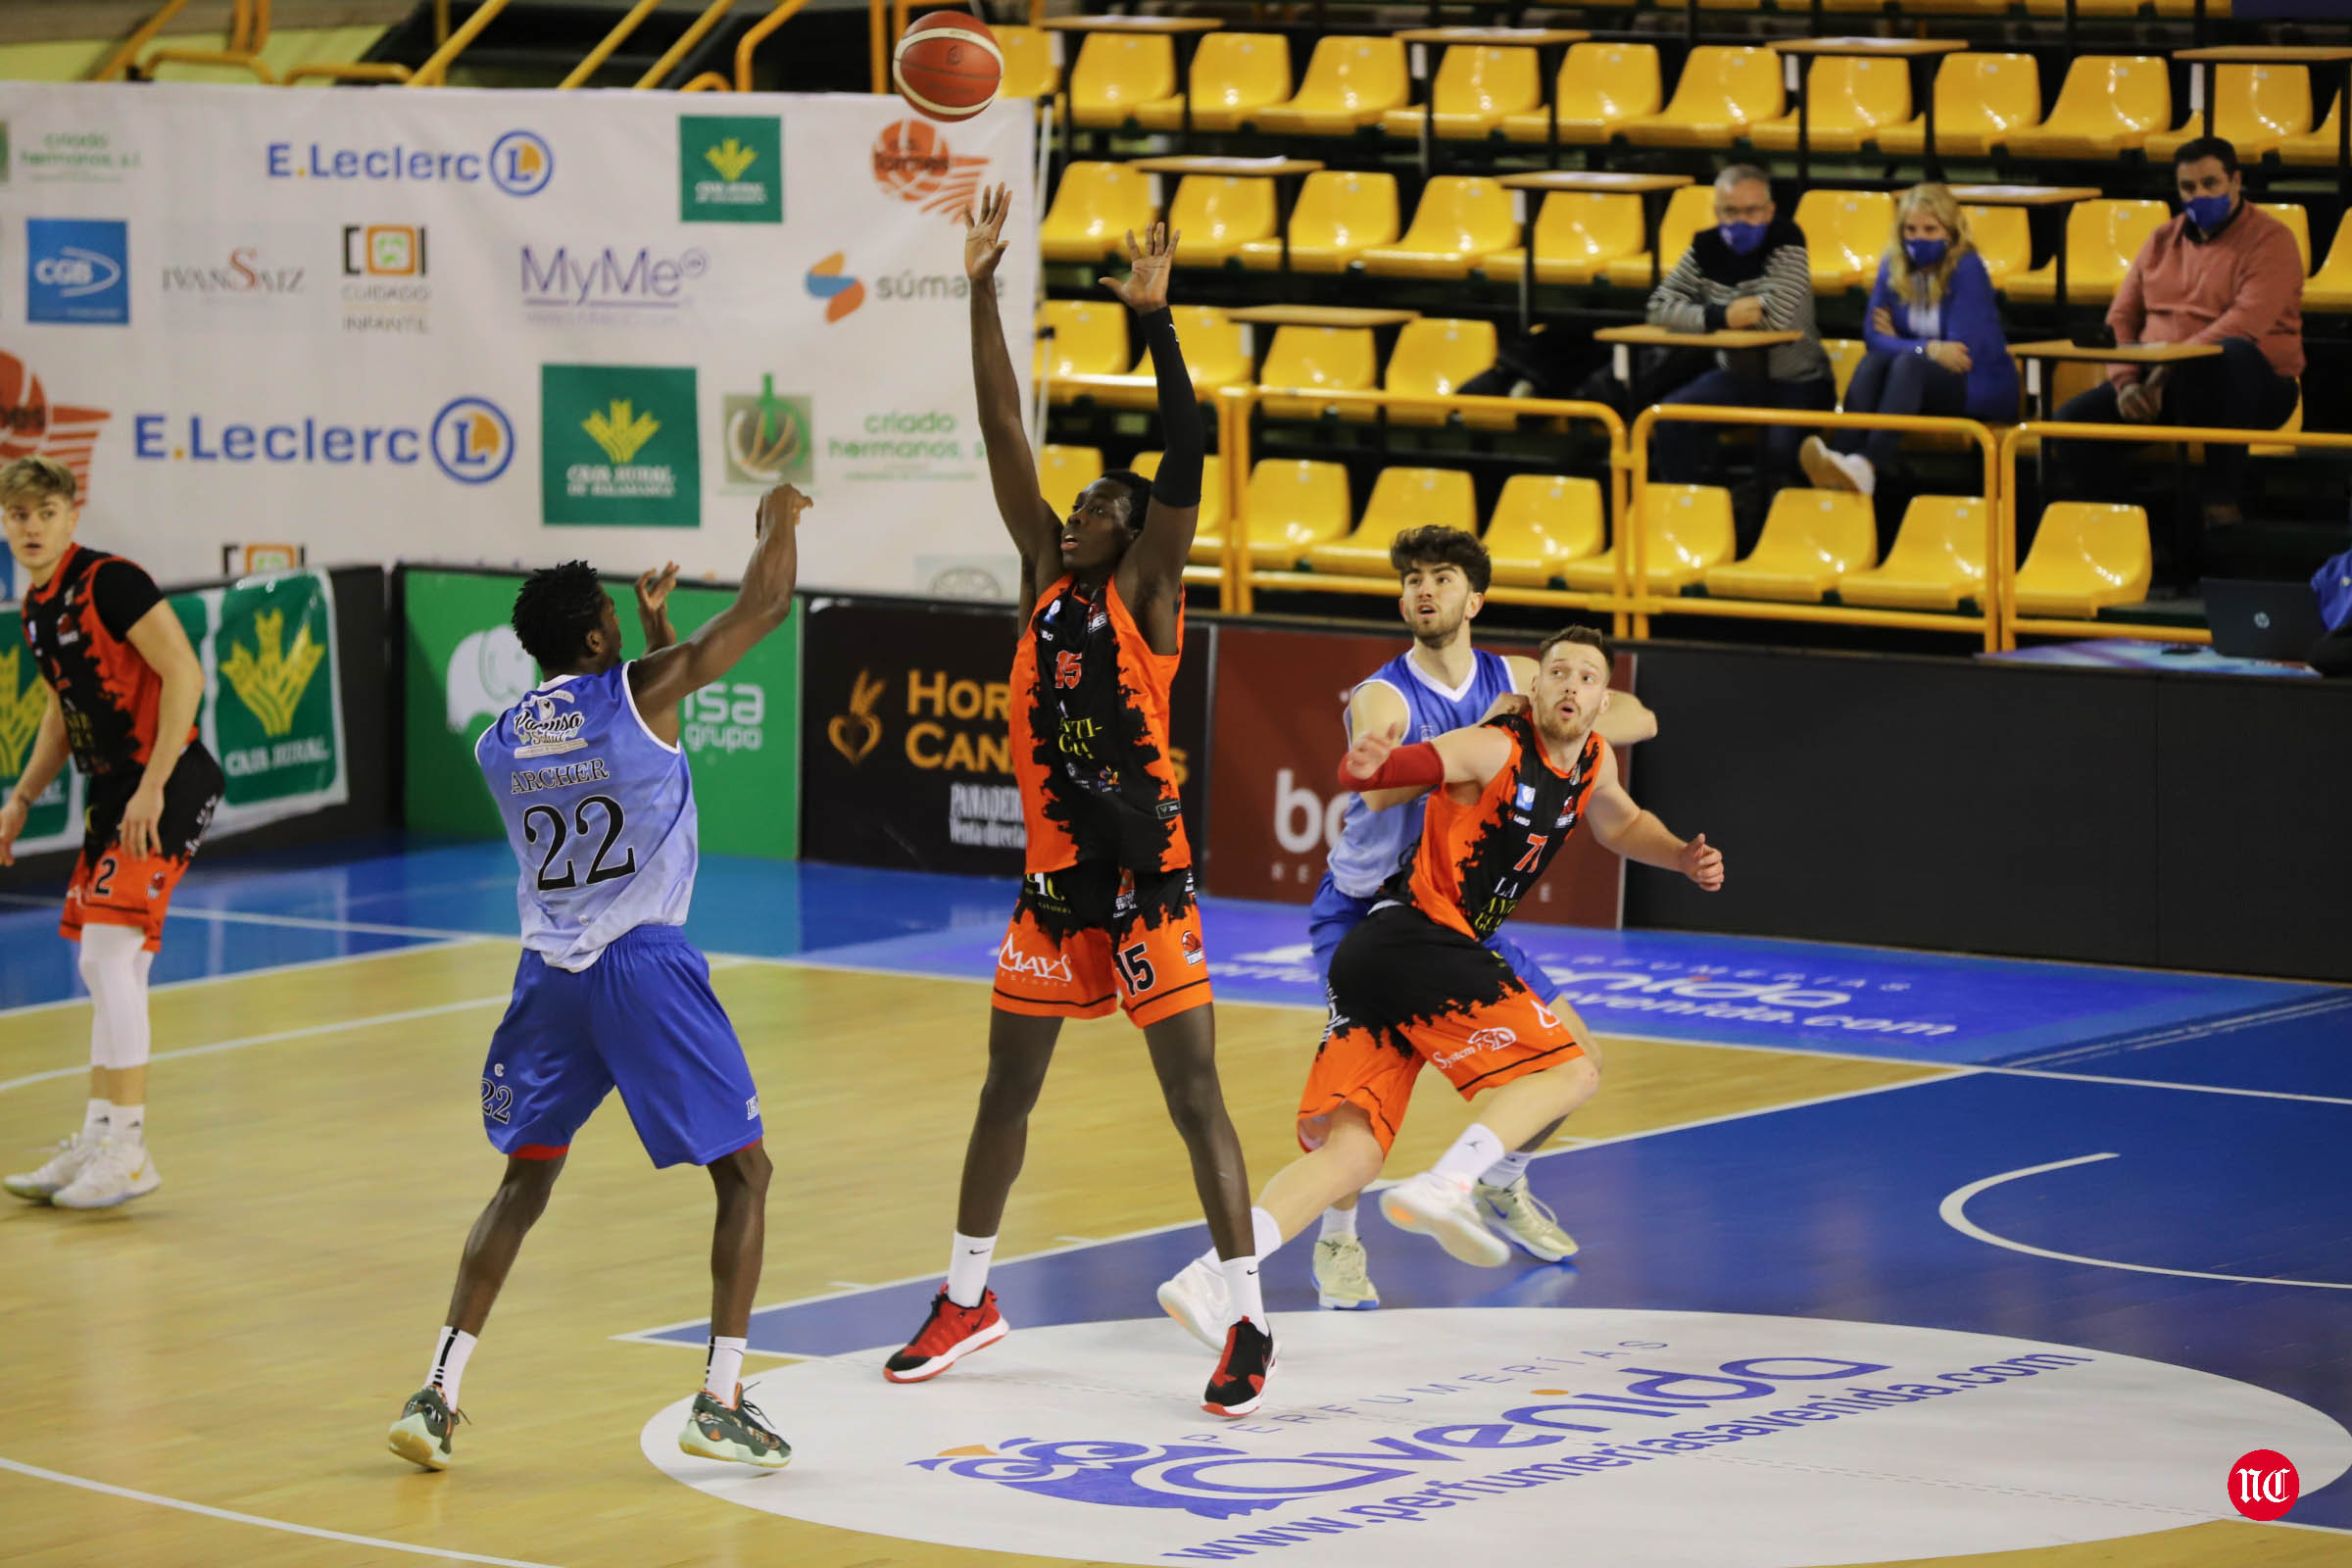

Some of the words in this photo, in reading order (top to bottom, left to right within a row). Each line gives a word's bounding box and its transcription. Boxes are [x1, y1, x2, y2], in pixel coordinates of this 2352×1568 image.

[267, 142, 481, 182] E.Leclerc
[520, 245, 679, 306] MyMe
[134, 415, 419, 464] E.Leclerc
[863, 412, 956, 434] criado
[906, 668, 1011, 721] HOR
[684, 724, 762, 753] grupo
[511, 758, 610, 795] ARCHER
[523, 794, 637, 892] 22
[95, 858, 117, 896] 2
[1115, 941, 1156, 998] 15
[480, 1078, 513, 1125] 22
[1160, 1352, 2096, 1560] www.perfumeriasavenida.com
